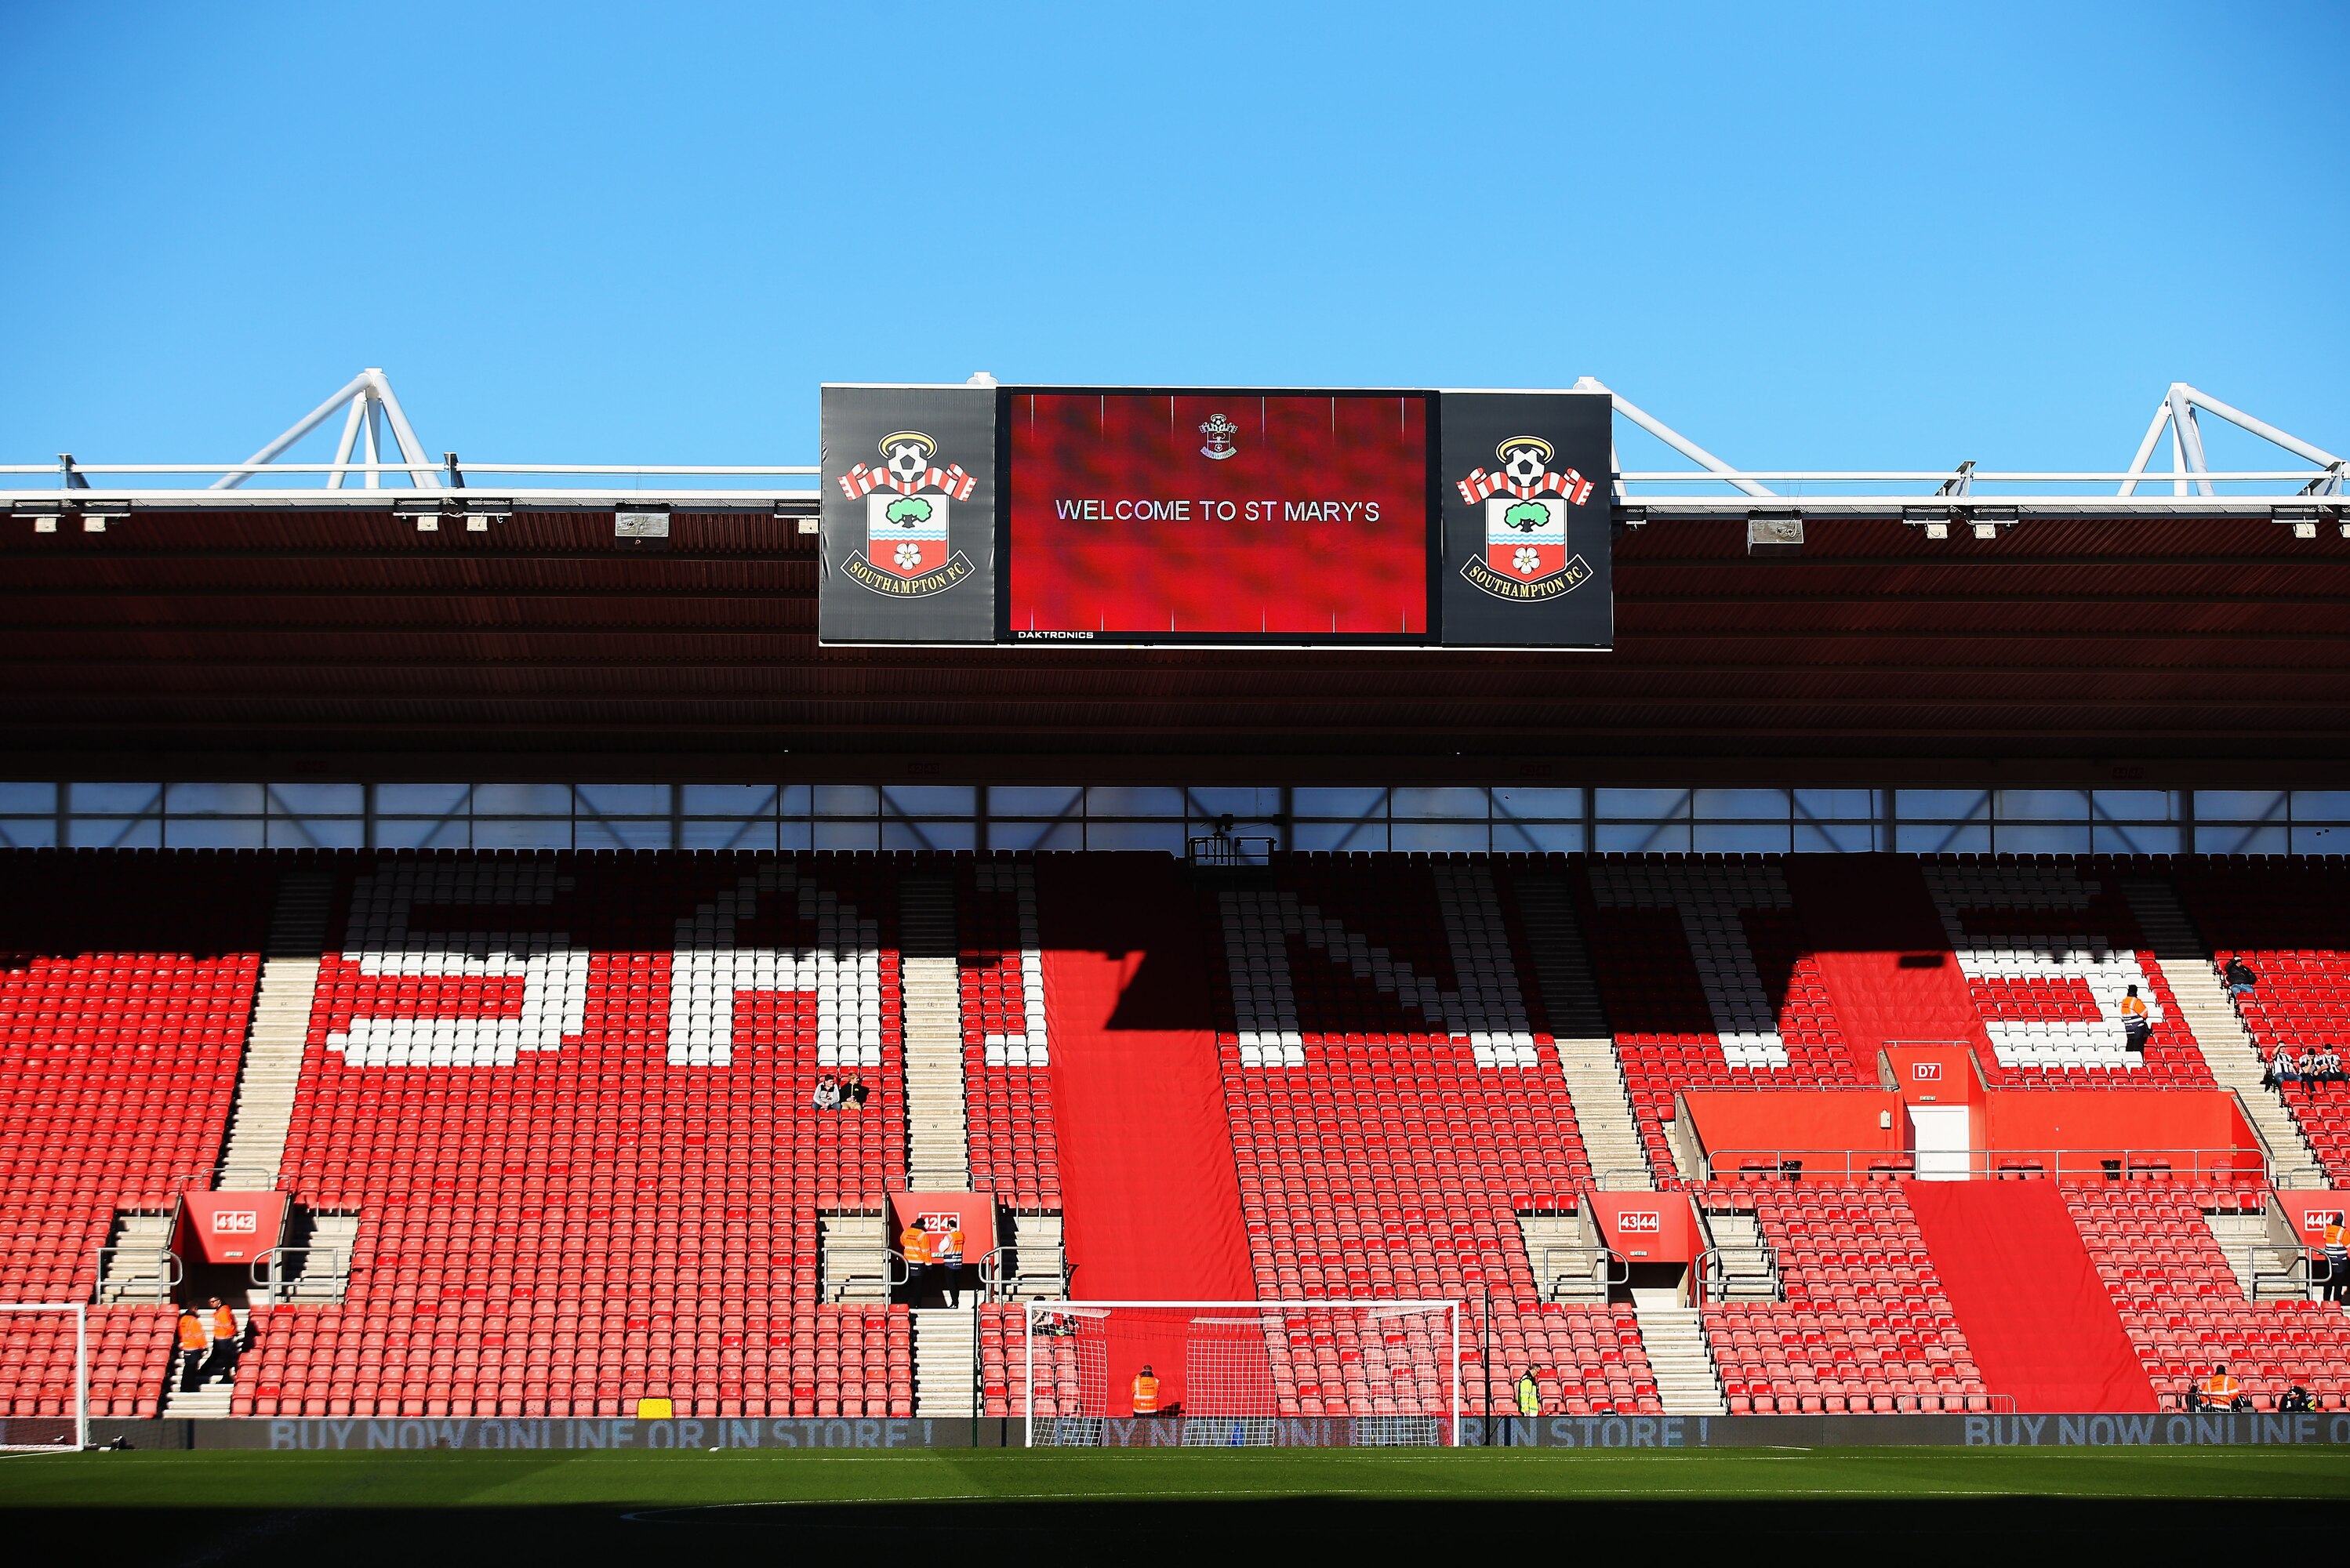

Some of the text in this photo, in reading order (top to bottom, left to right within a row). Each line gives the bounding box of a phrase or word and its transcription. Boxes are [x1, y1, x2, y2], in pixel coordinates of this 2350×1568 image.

[1055, 499, 1381, 523] WELCOME TO ST MARY'S
[849, 561, 966, 594] SOUTHAMPTON FC
[1469, 564, 1584, 598] SOUTHAMPTON FC
[1018, 630, 1095, 640] DAKTRONICS
[1918, 1065, 1937, 1078] D7
[236, 1214, 255, 1229] 42
[1621, 1215, 1657, 1229] 43 44
[2307, 1214, 2324, 1227] 44
[270, 1420, 355, 1449] BUY
[366, 1420, 468, 1449] NOW
[647, 1419, 704, 1449] OR
[717, 1419, 760, 1448] IN
[1964, 1416, 2048, 1446] BUY
[2058, 1415, 2157, 1446] NOW
